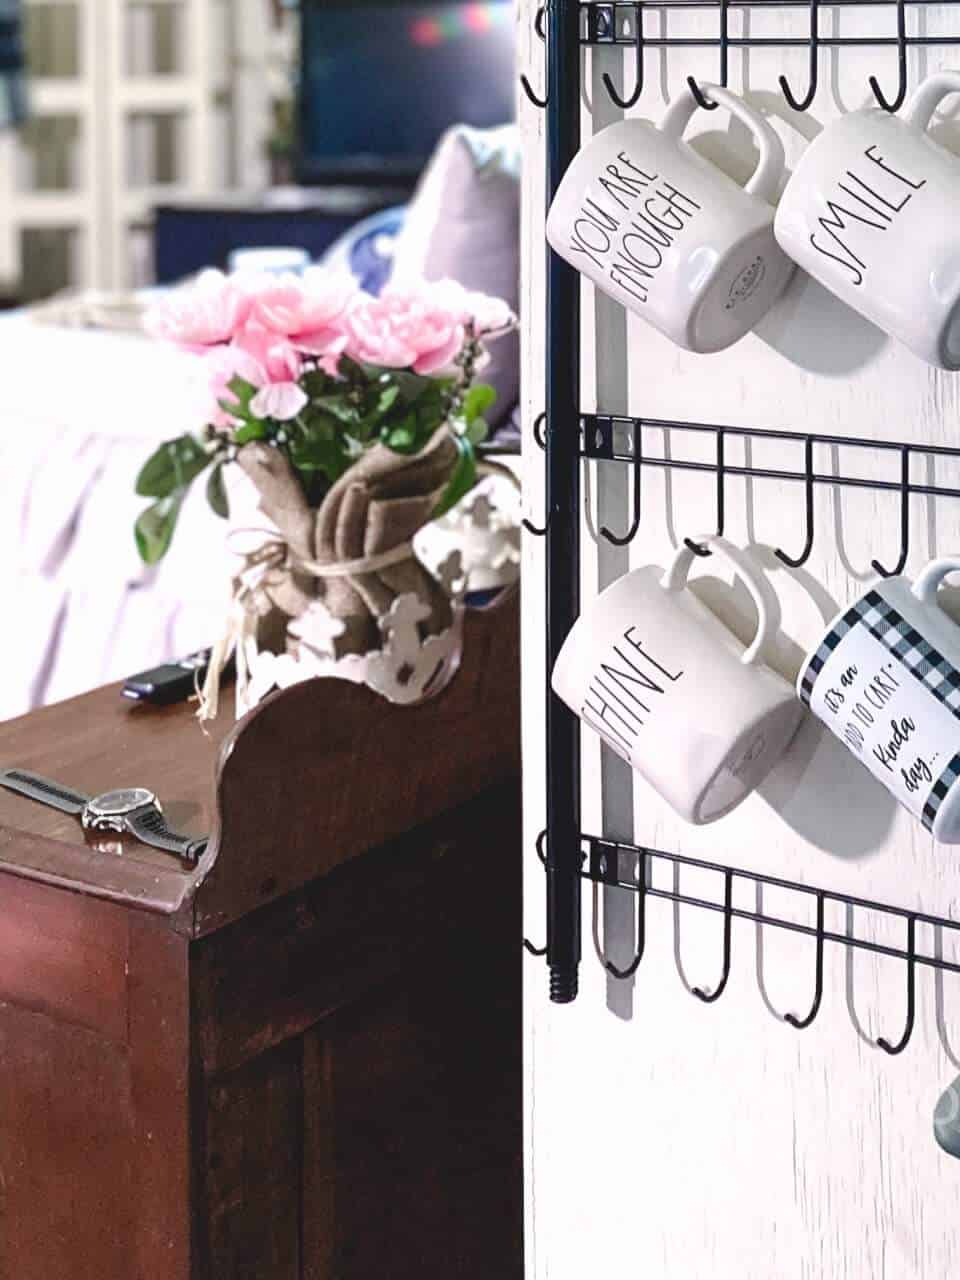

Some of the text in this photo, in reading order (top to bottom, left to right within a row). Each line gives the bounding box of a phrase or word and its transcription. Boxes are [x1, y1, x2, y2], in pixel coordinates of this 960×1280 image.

[570, 151, 660, 269] YOU ARE
[609, 182, 702, 304] ENOUGH
[809, 144, 927, 286] SMILE
[839, 663, 859, 688] an
[851, 702, 875, 729] TO
[863, 666, 901, 710] CART
